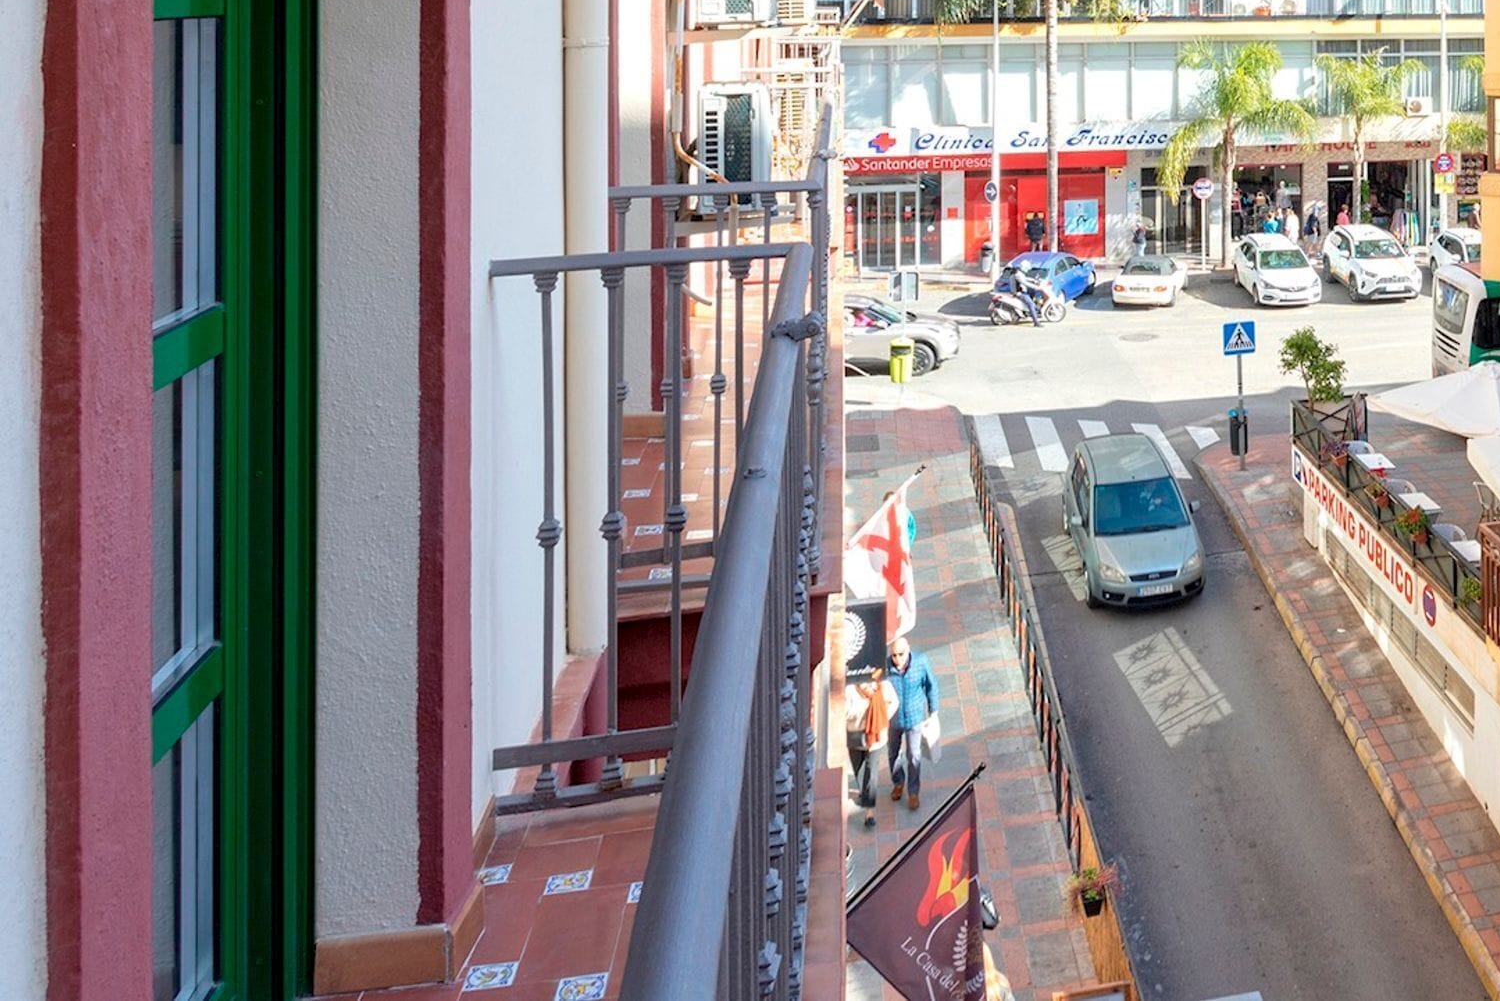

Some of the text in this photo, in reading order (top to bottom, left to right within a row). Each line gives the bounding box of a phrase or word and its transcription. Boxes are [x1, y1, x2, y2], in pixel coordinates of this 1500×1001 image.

[1066, 129, 1172, 147] Francisc
[861, 156, 993, 172] Santander Empresas
[1308, 468, 1356, 541] PARKING
[1358, 522, 1414, 605] PUBLICO
[900, 936, 960, 993] La Casa del
